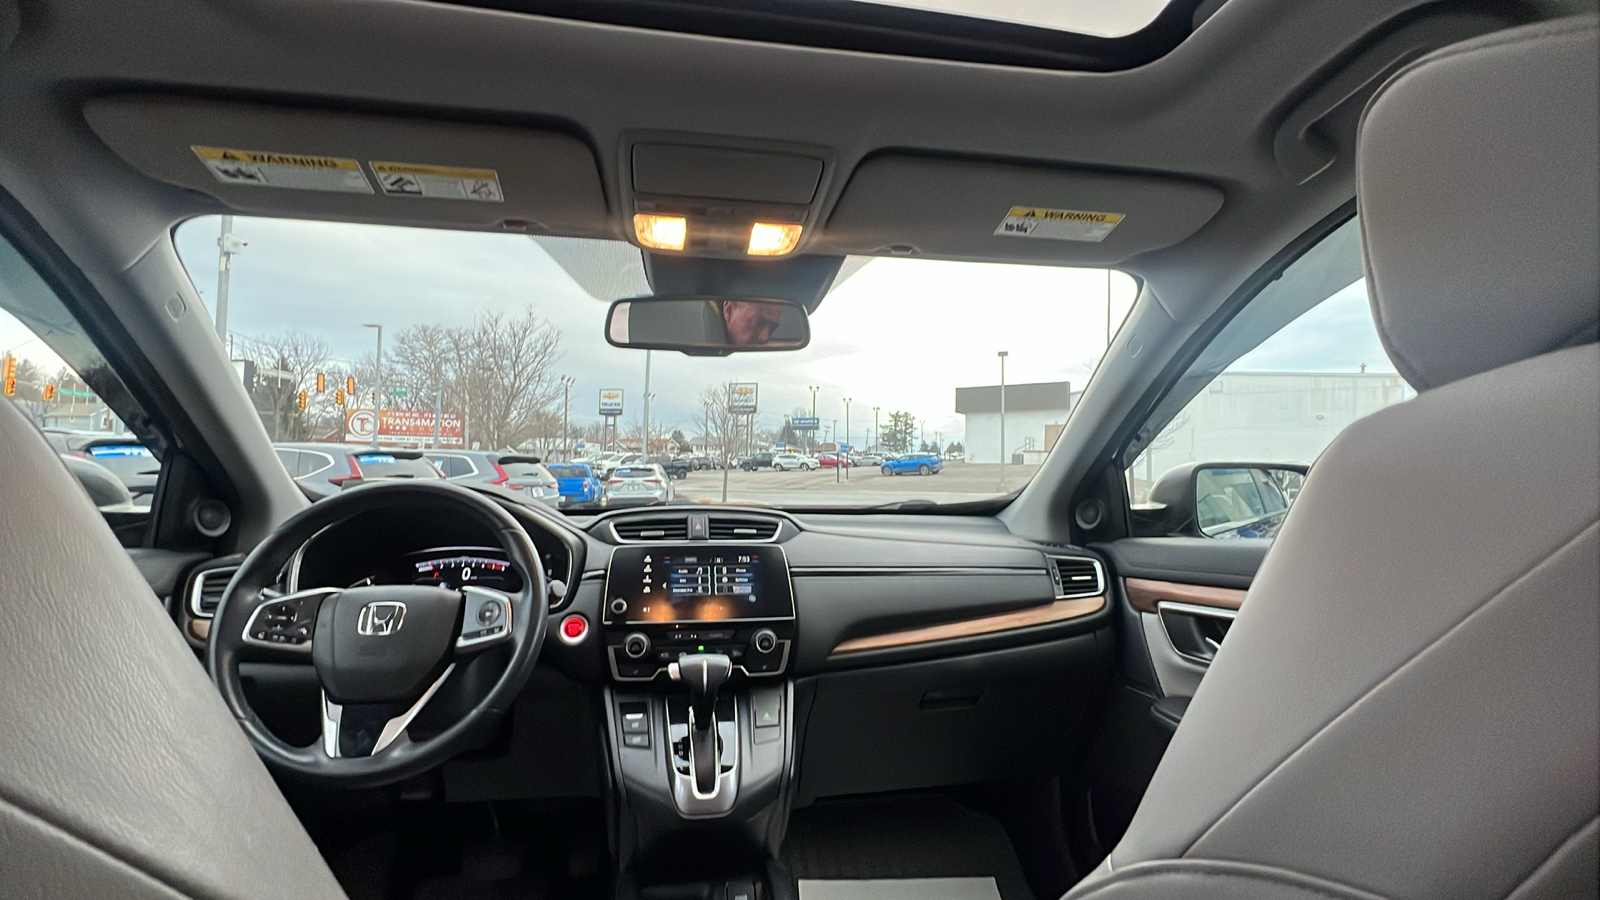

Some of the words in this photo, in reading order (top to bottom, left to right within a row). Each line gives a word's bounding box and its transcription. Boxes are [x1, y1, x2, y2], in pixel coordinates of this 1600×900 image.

[248, 154, 337, 167] WARNING
[1044, 210, 1106, 221] WARNING
[462, 567, 471, 581] 0
